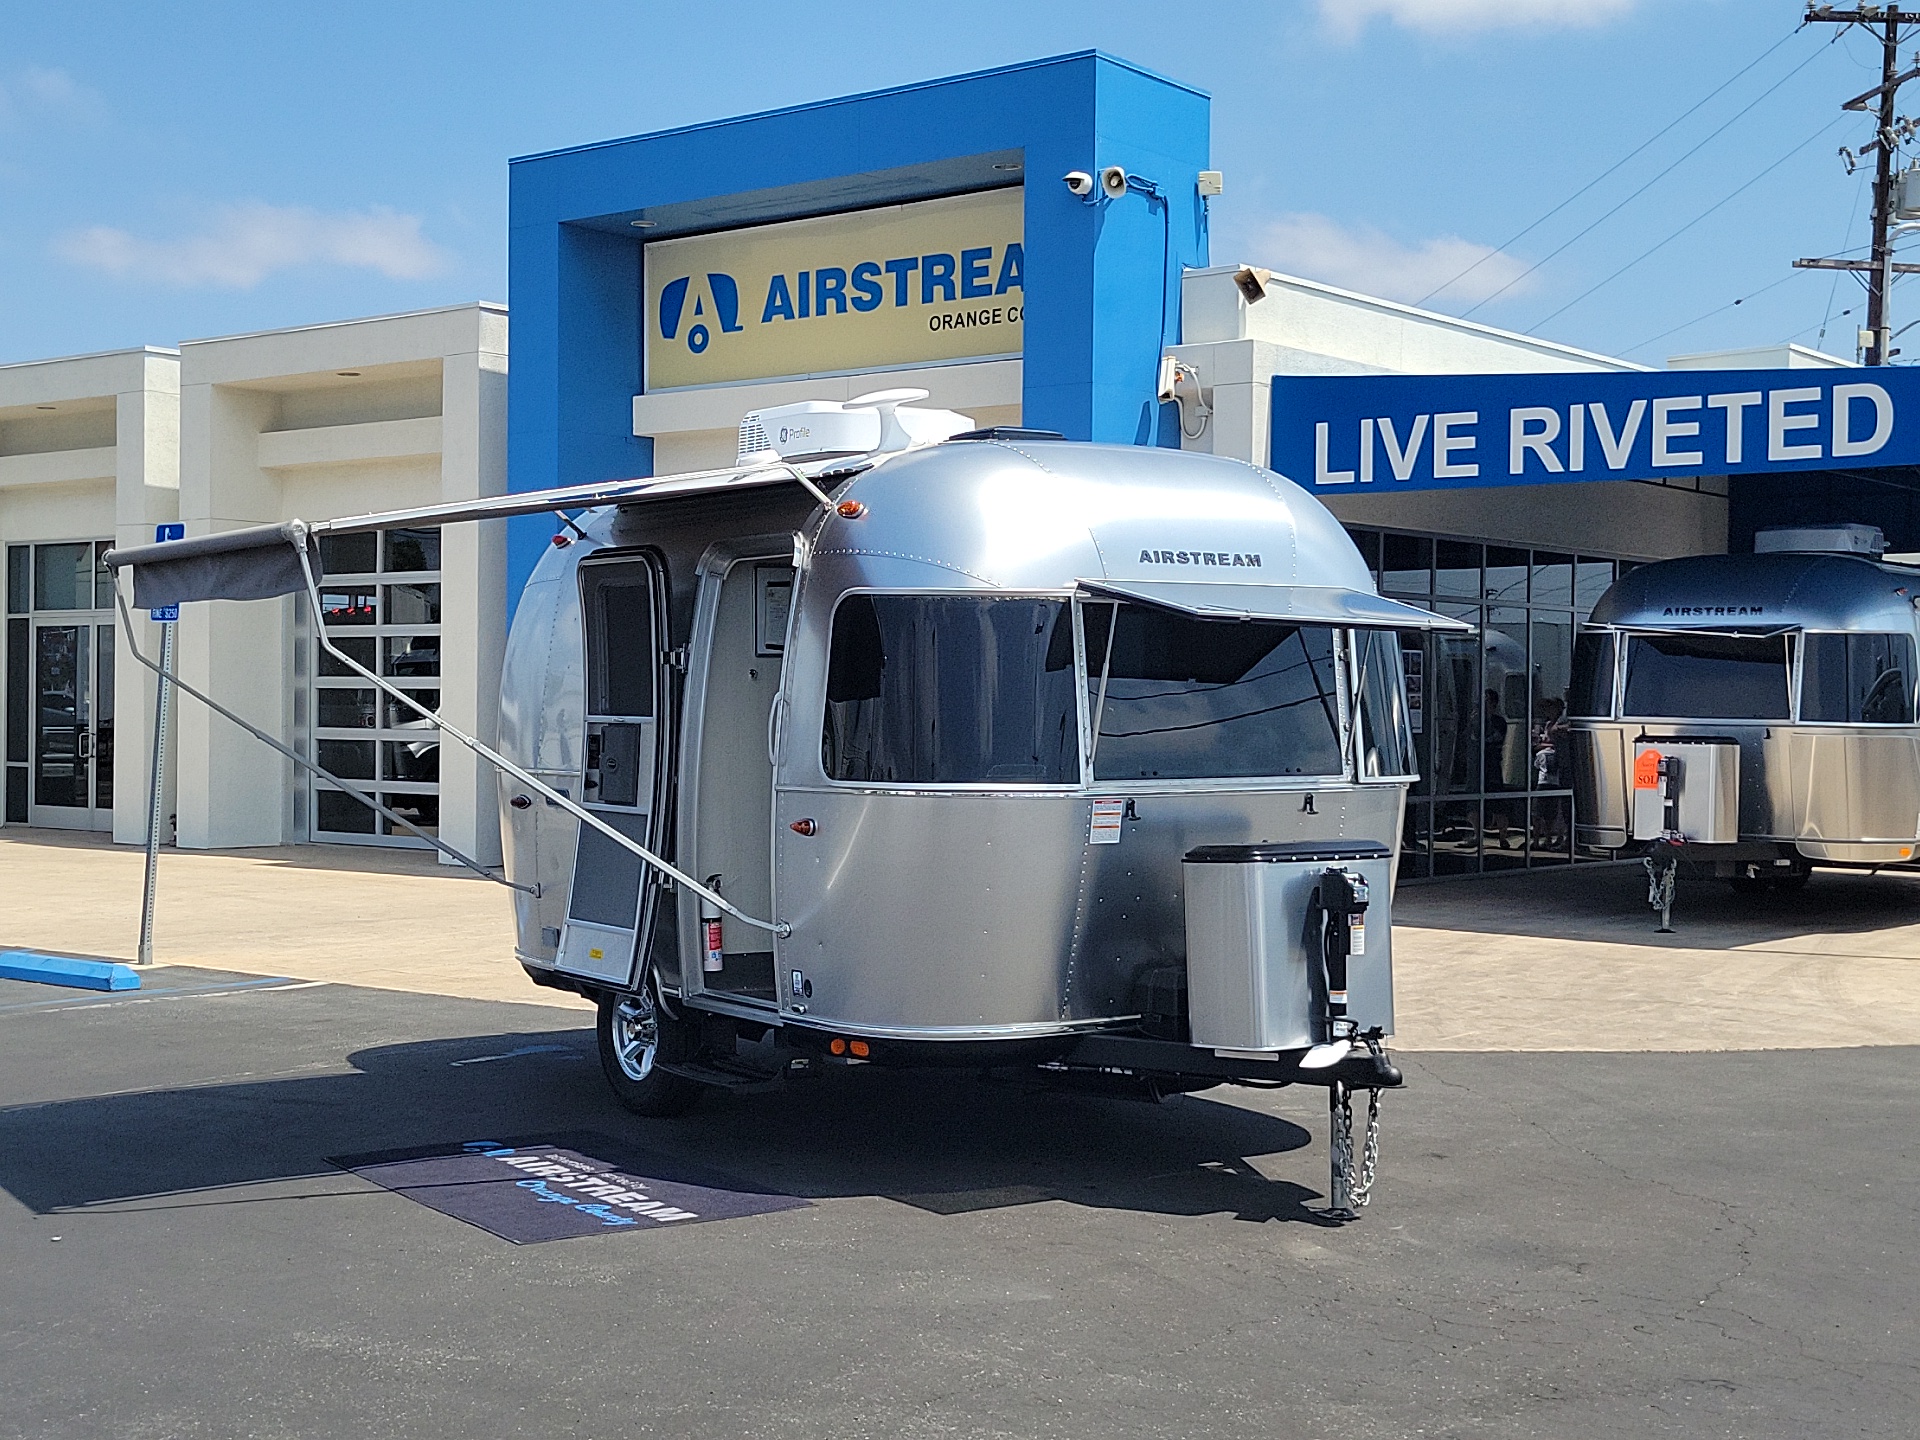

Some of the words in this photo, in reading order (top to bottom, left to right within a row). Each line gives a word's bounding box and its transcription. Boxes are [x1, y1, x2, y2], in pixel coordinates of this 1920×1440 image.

[761, 243, 1024, 323] AIRSTREA
[929, 308, 1002, 331] ORANGE
[1315, 411, 1480, 485] LIVE
[1509, 383, 1894, 475] RIVETED
[1139, 549, 1262, 567] AIRSTREAM
[1662, 606, 1764, 617] AIRSTREAM
[495, 1156, 699, 1222] AIRSTREAM
